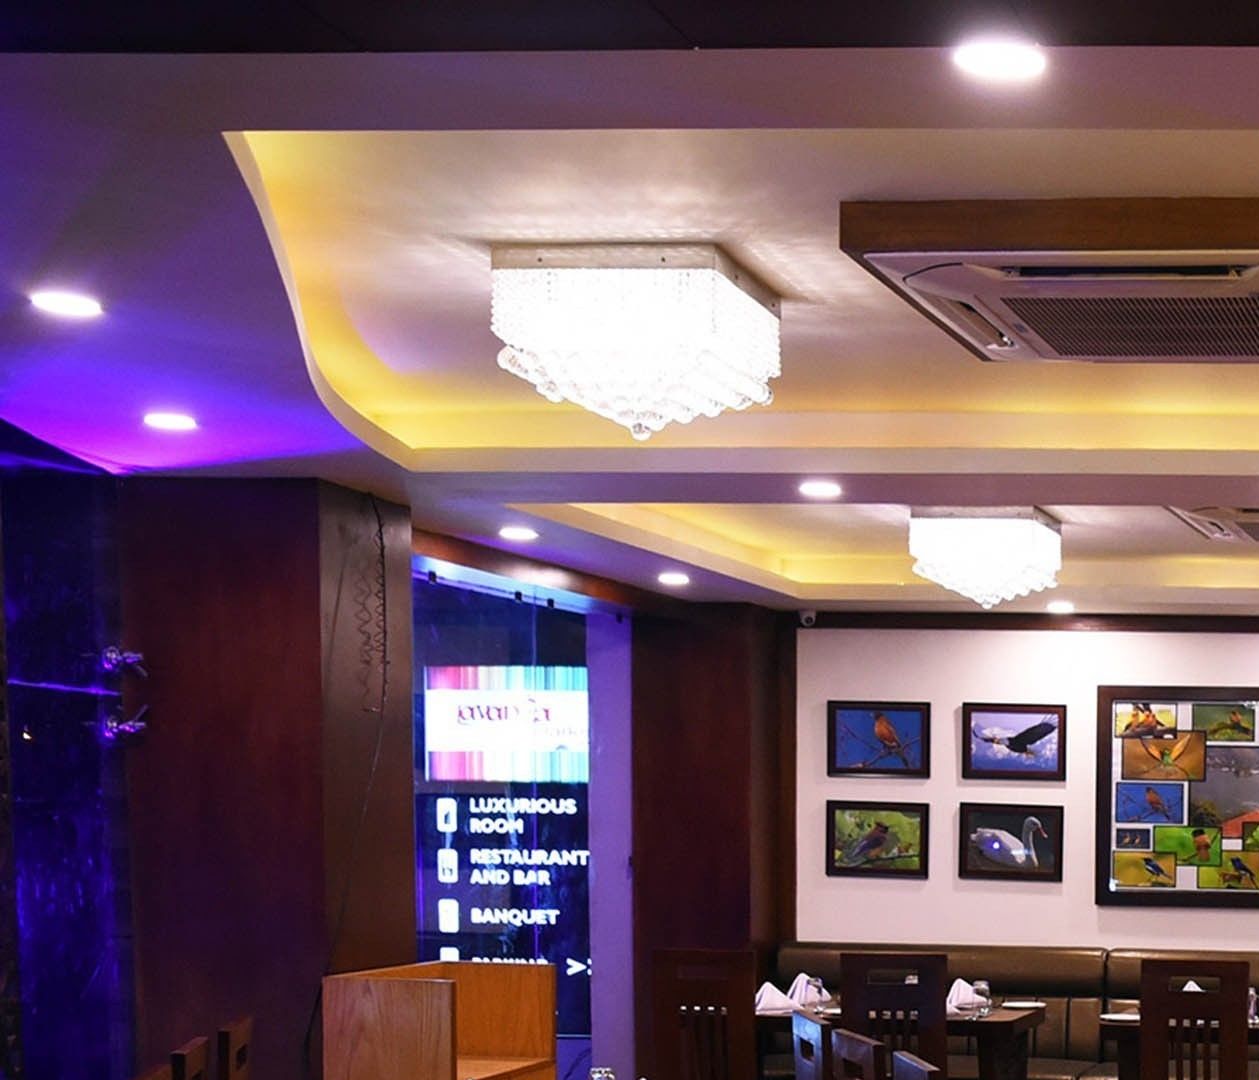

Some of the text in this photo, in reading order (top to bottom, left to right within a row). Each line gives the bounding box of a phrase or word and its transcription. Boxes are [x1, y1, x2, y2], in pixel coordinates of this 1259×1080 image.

[469, 797, 578, 815] LUXURIOUS
[469, 818, 524, 834] ROOM
[470, 849, 591, 866] RESTAURANT
[470, 868, 552, 886] AND BAR
[470, 908, 561, 926] BANQUET
